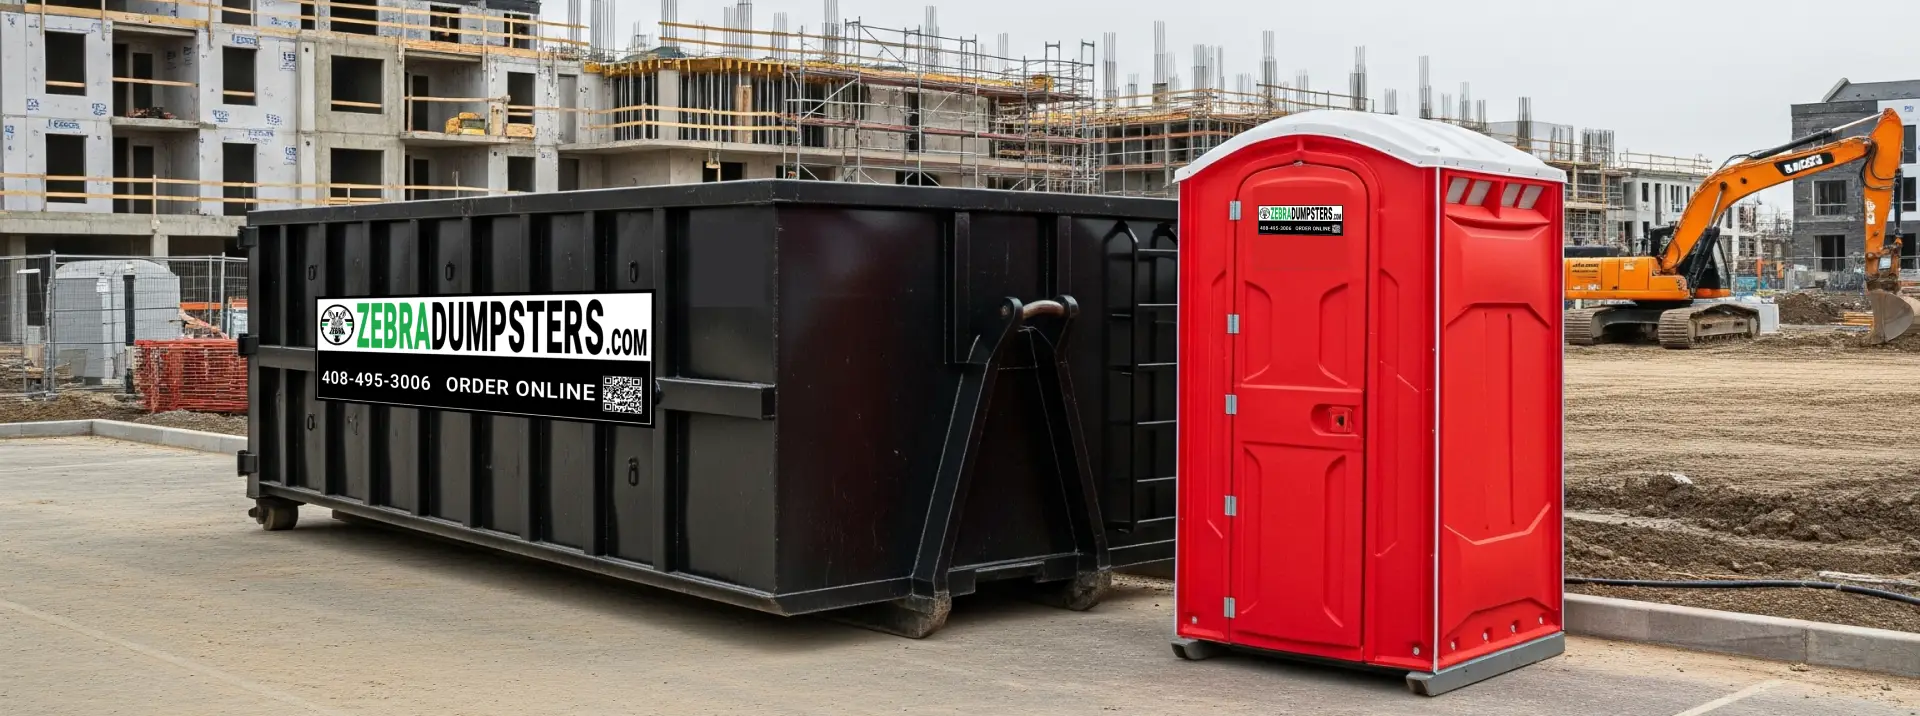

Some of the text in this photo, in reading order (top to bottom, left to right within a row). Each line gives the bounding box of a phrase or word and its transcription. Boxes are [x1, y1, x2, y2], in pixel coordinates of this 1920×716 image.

[356, 299, 647, 356] ZEBRADUMPSTERS.COM
[322, 370, 596, 401] 408-495-3006 ORDER ONLINE
